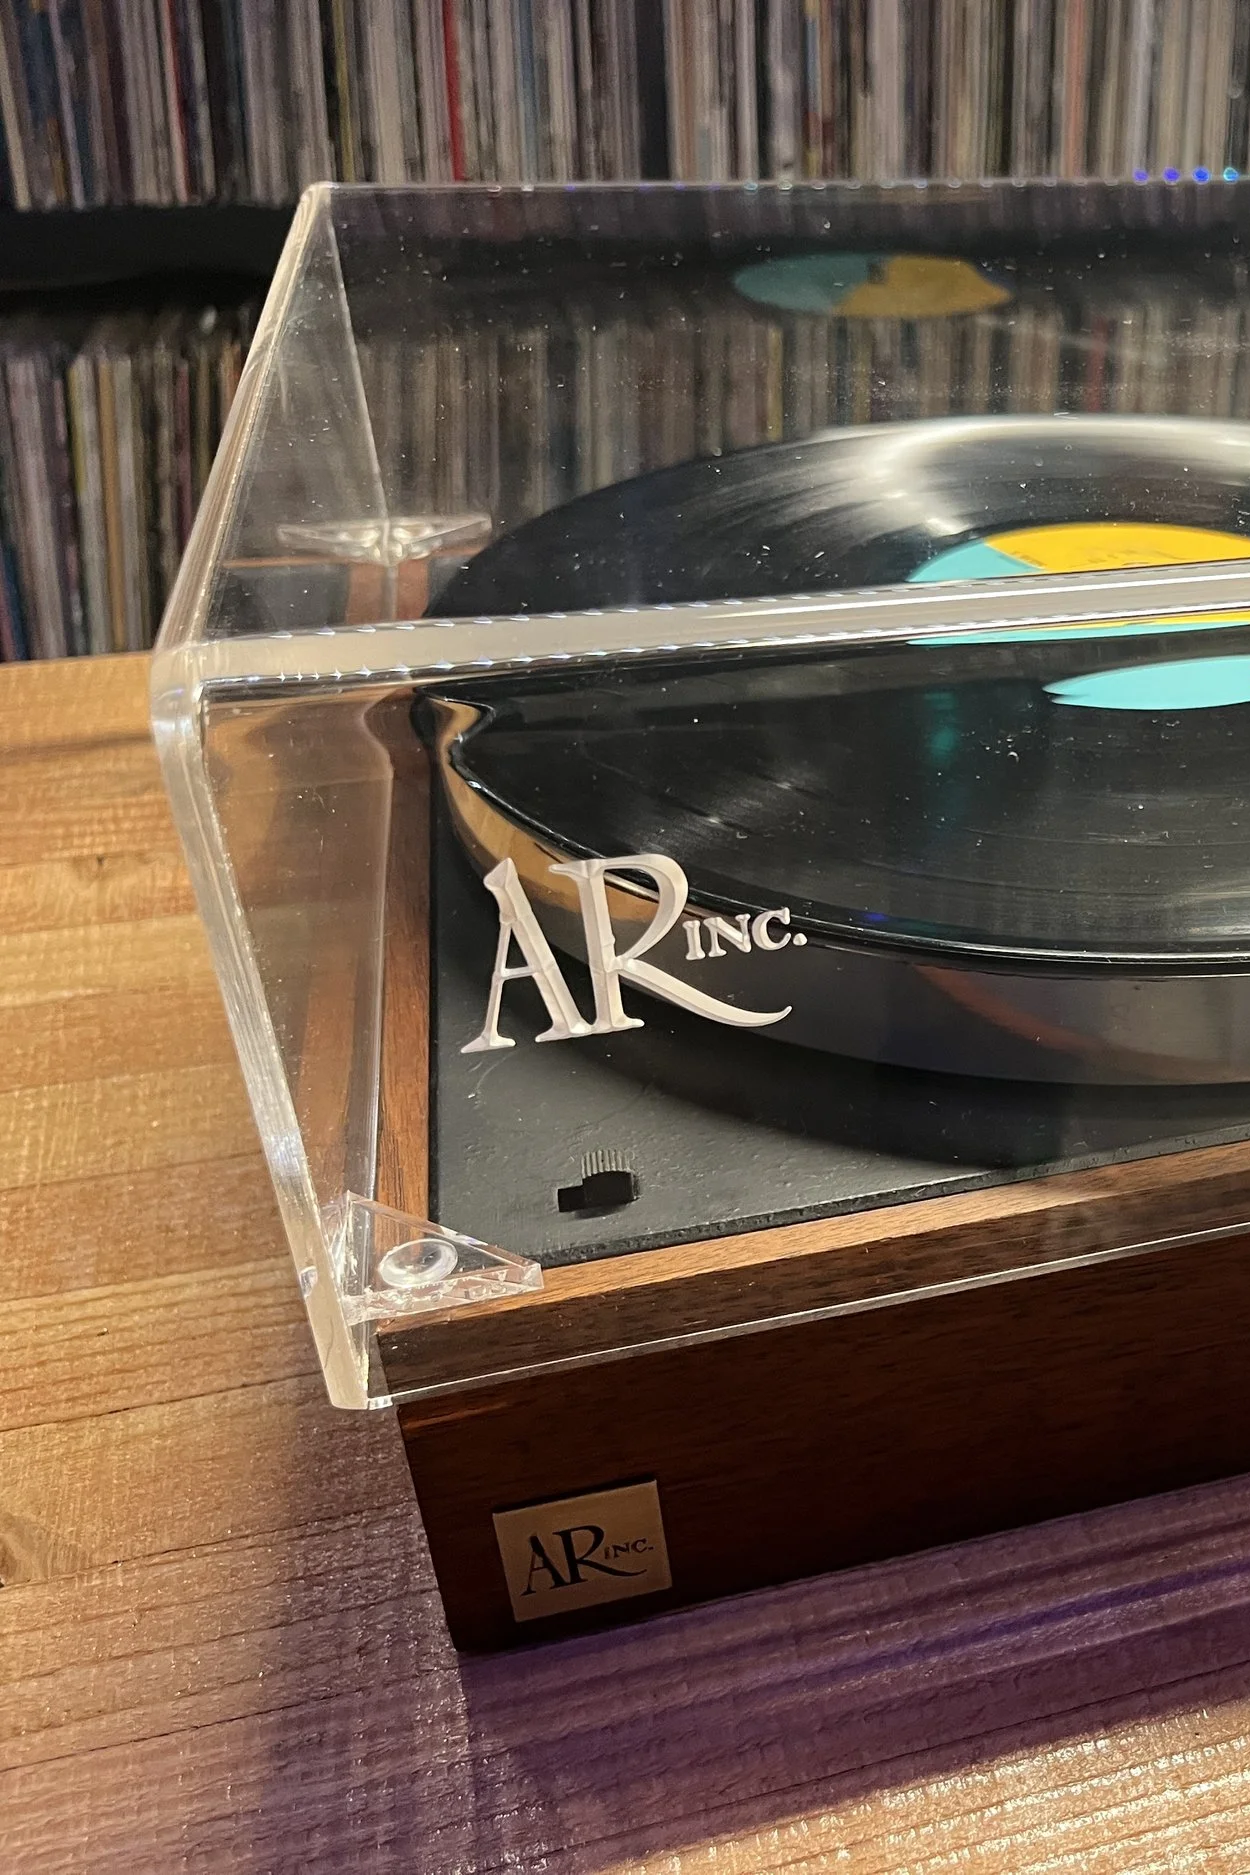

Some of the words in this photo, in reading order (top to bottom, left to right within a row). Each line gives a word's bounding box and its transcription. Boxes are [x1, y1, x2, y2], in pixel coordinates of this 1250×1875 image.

[460, 853, 792, 1053] AR
[682, 907, 808, 960] INC.
[521, 1525, 647, 1596] AR
[604, 1538, 654, 1560] INC.
